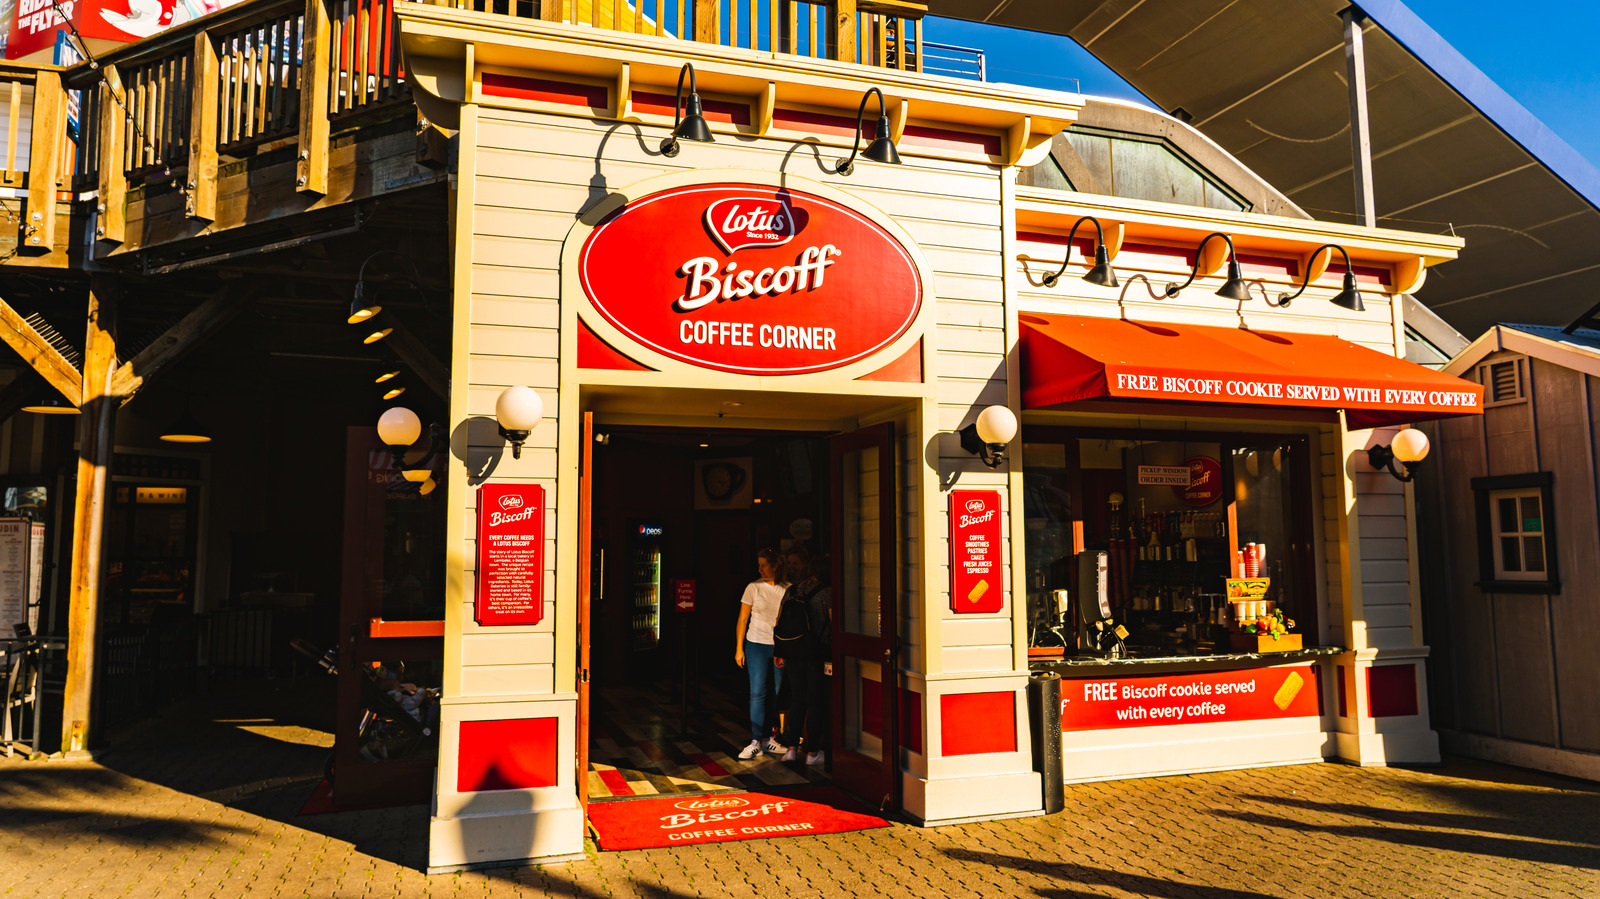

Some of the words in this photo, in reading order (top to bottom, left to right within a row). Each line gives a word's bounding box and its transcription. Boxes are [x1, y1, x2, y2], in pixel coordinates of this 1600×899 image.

[18, 16, 31, 29] THE
[680, 320, 754, 346] COFFEE
[759, 324, 836, 350] CORNER
[1116, 373, 1158, 391] FREE
[1162, 376, 1222, 394] BISCOFF
[1226, 380, 1283, 398] COOKIE
[1286, 384, 1340, 400] SERVED
[1343, 387, 1381, 402] WITH
[1385, 389, 1428, 404] EVERY
[1429, 391, 1477, 406] COFFEE
[489, 507, 535, 526] Biscoff
[959, 510, 994, 528] Biscoff
[1084, 682, 1117, 702] FREE
[1122, 683, 1167, 700] Biscoff
[1170, 681, 1212, 697] cookie
[1214, 680, 1256, 694] served
[1116, 705, 1146, 720] with
[1150, 706, 1184, 720] every
[1186, 702, 1226, 716] coffee
[660, 802, 789, 829] Biscoff
[668, 828, 738, 840] COFFEE
[741, 822, 814, 834] CORNER
